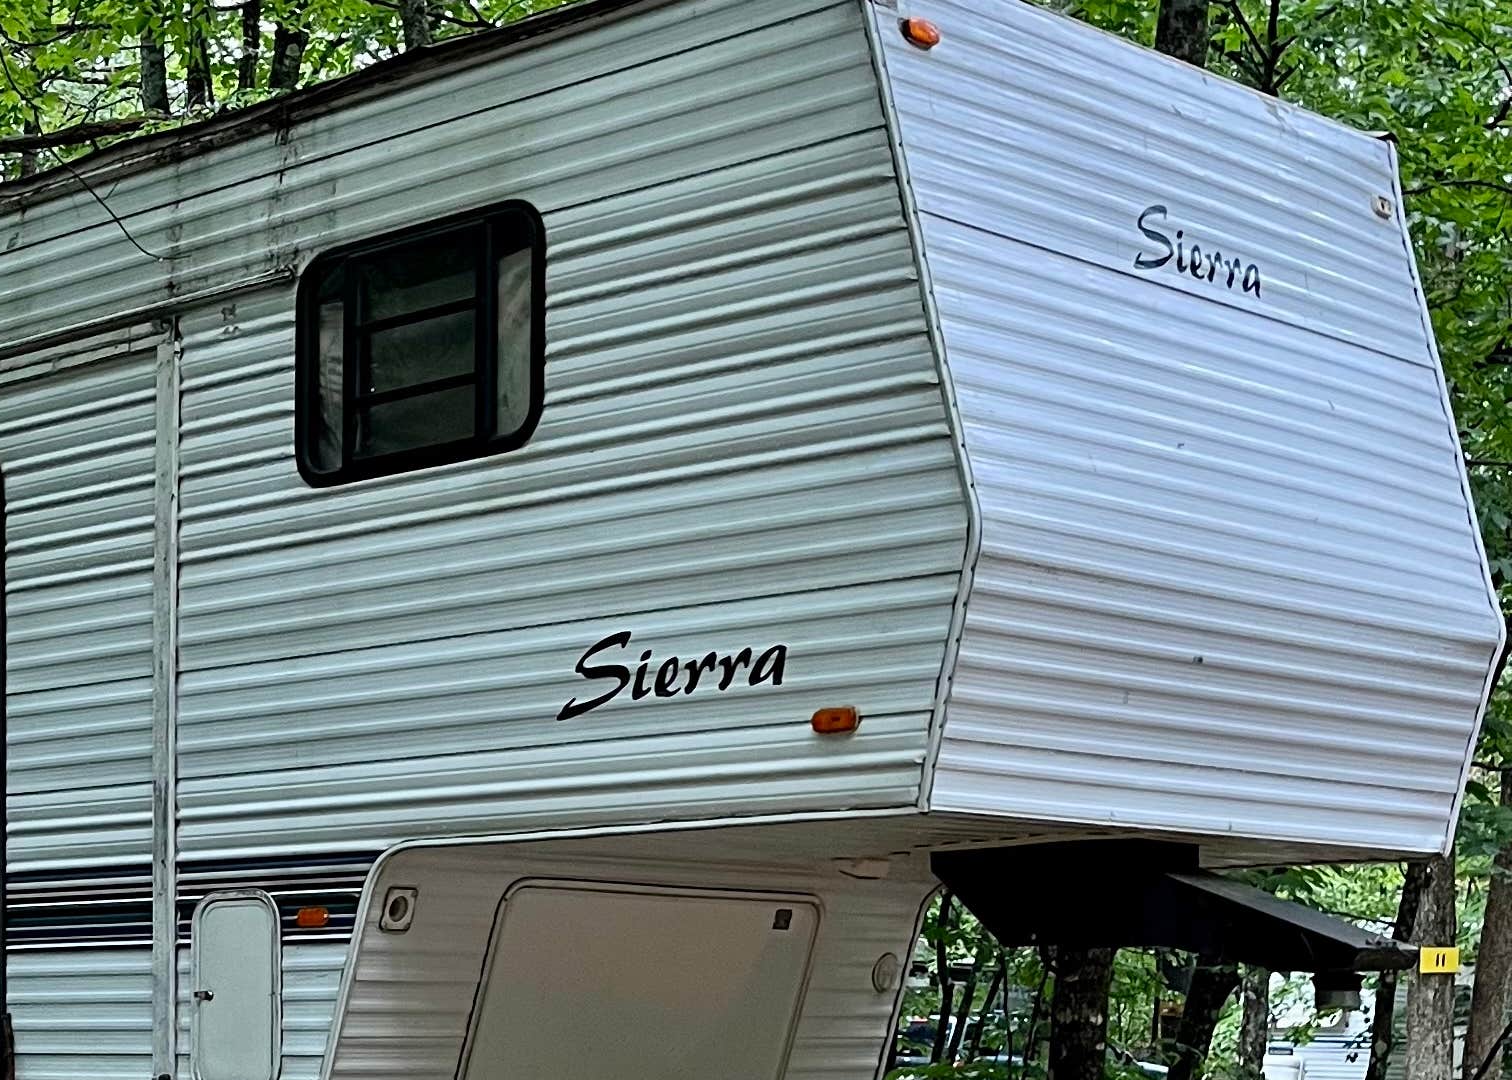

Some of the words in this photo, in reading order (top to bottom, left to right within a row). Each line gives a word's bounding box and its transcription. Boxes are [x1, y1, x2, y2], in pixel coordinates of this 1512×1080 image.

[1133, 205, 1261, 299] Sierra
[556, 630, 788, 721] Sierra
[1435, 953, 1446, 968] 11
